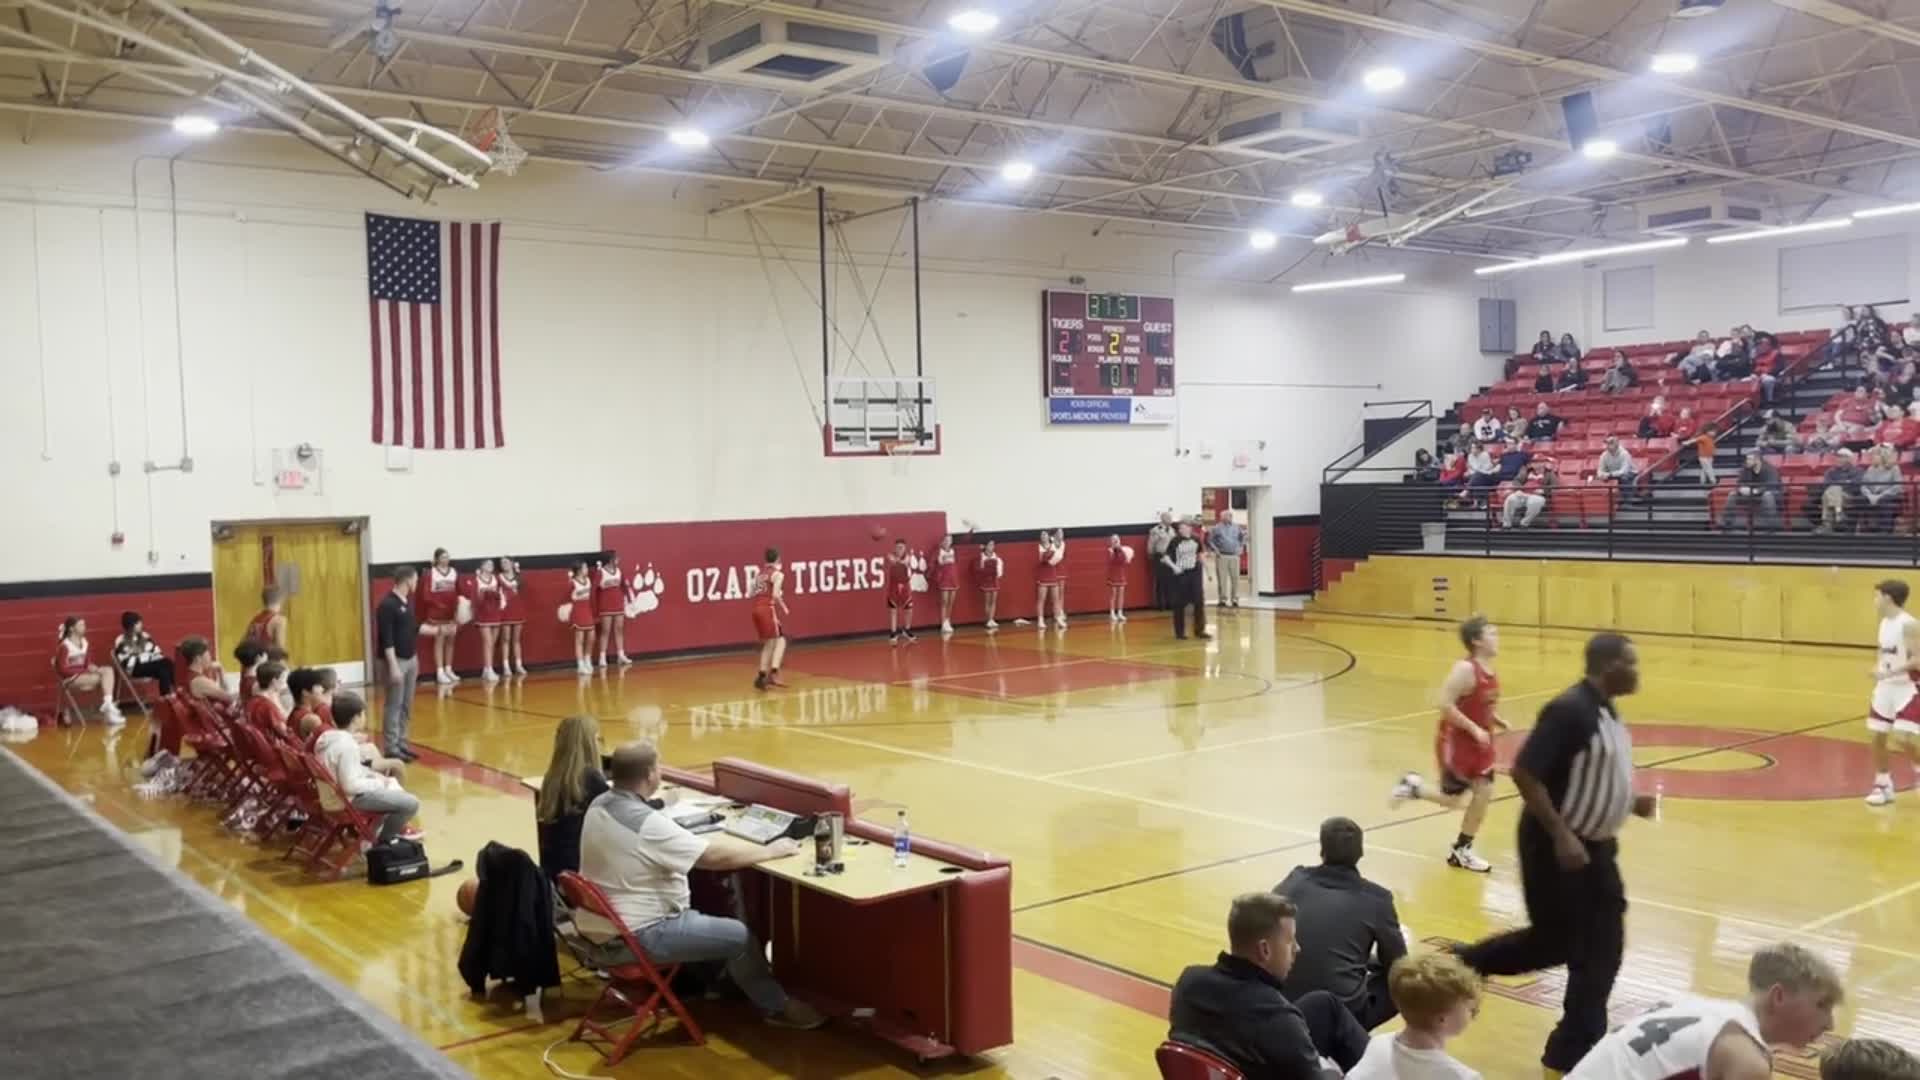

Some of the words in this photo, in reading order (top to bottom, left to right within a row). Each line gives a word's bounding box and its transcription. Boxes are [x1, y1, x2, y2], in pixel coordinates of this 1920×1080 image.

[1052, 318, 1084, 330] TIGERS
[1143, 322, 1172, 333] GUEST
[1060, 331, 1070, 353] 2
[1109, 333, 1120, 354] 2
[686, 565, 762, 602] OZAR
[791, 557, 885, 594] TIGERS
